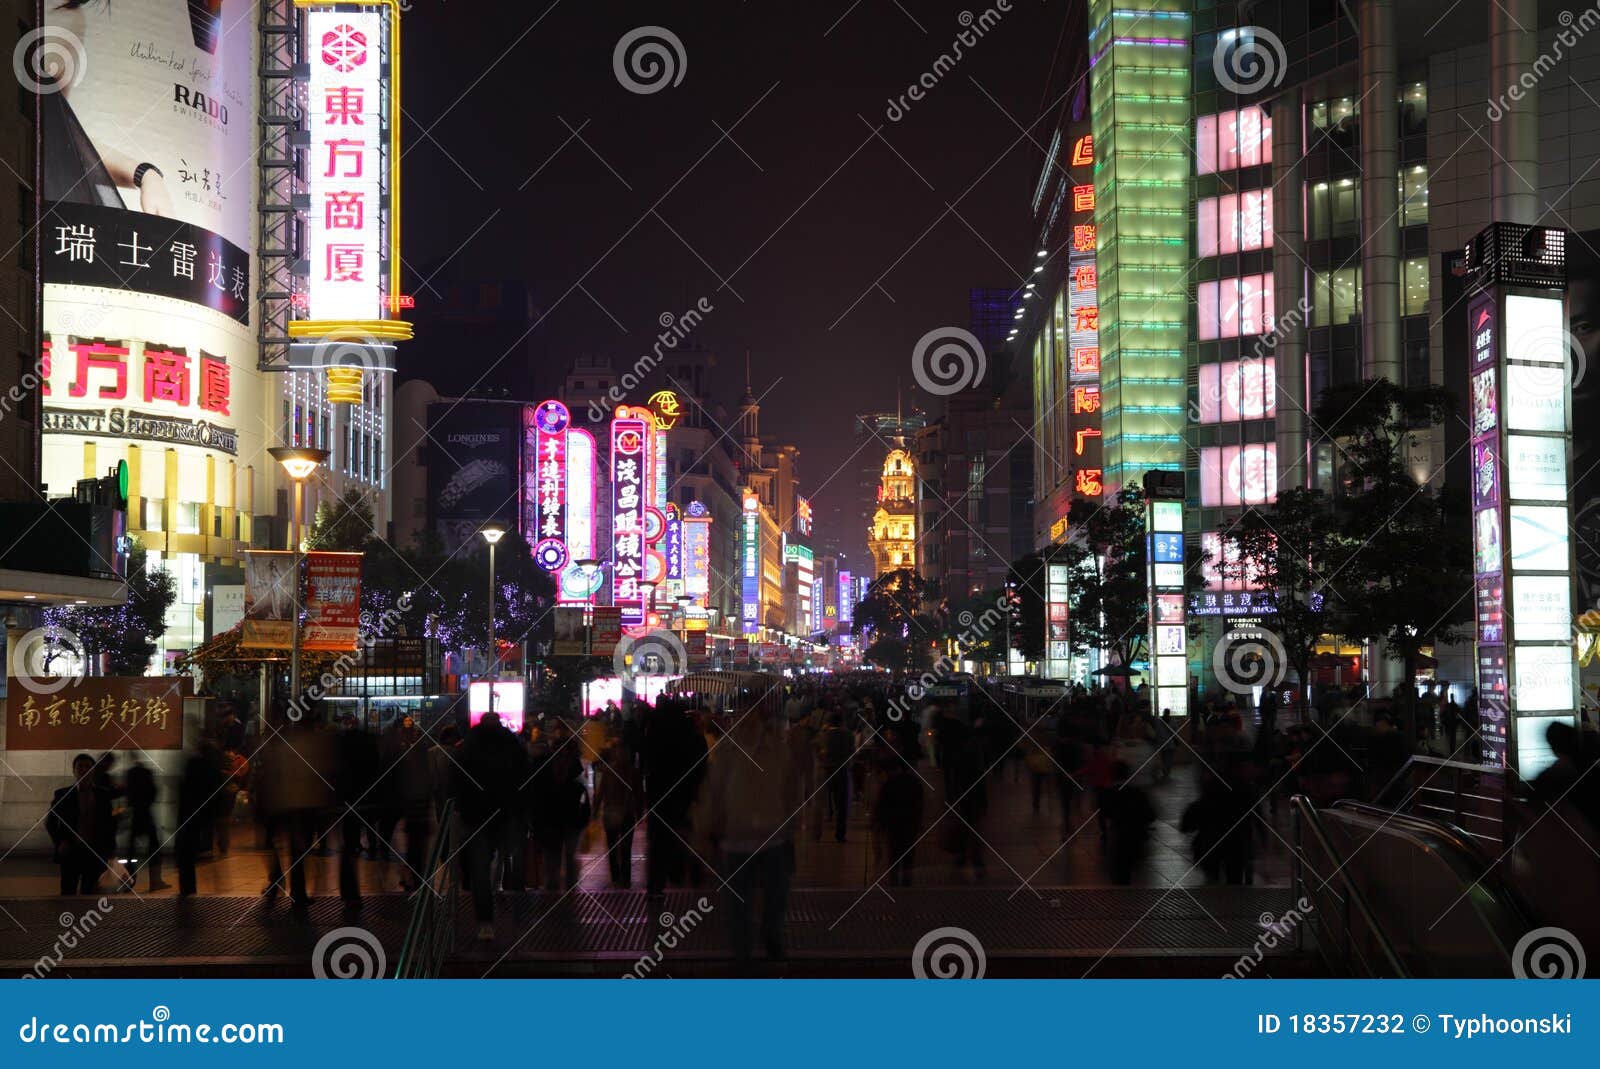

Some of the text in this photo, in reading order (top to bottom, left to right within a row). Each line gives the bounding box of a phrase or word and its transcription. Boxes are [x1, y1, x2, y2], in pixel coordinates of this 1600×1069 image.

[173, 83, 229, 125] RADO
[54, 223, 246, 303] 瑞士雷达表
[42, 341, 231, 416] 方商厦
[447, 433, 500, 443] LONGINES
